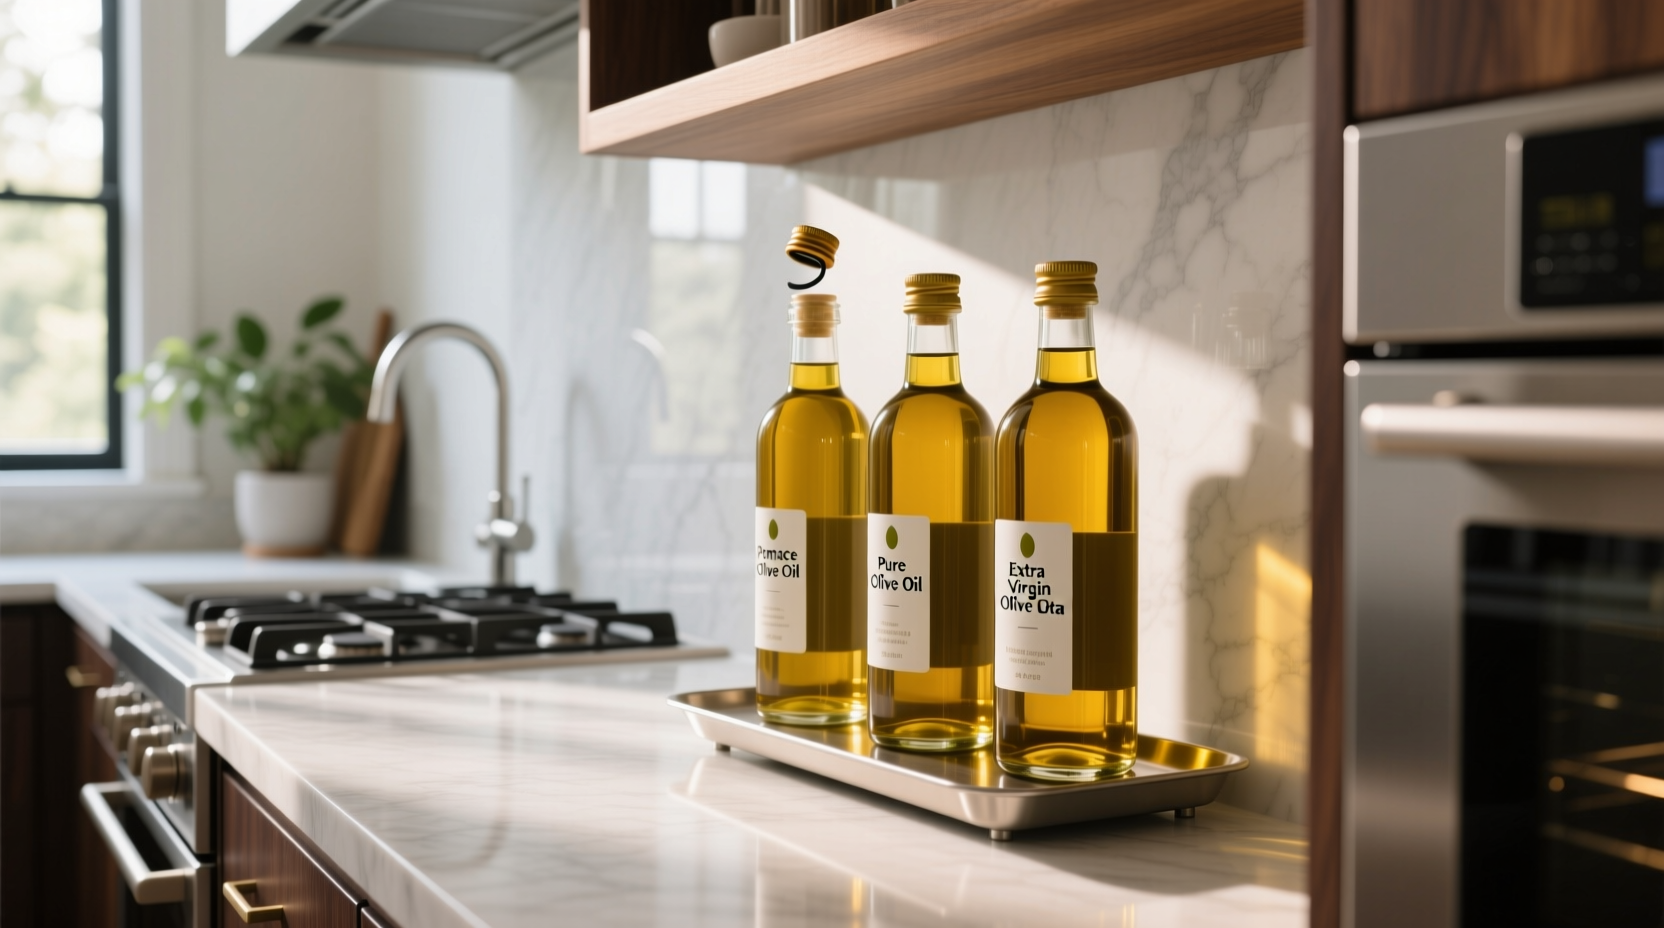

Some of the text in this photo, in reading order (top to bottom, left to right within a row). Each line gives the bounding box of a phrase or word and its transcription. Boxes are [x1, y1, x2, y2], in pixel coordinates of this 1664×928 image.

[757, 562, 800, 578] Olive Oil
[878, 556, 906, 572] Pure
[1009, 561, 1045, 578] Extra
[871, 573, 922, 592] Olive Oil
[1007, 578, 1051, 600] Virgin
[1000, 595, 1033, 613] Olive
